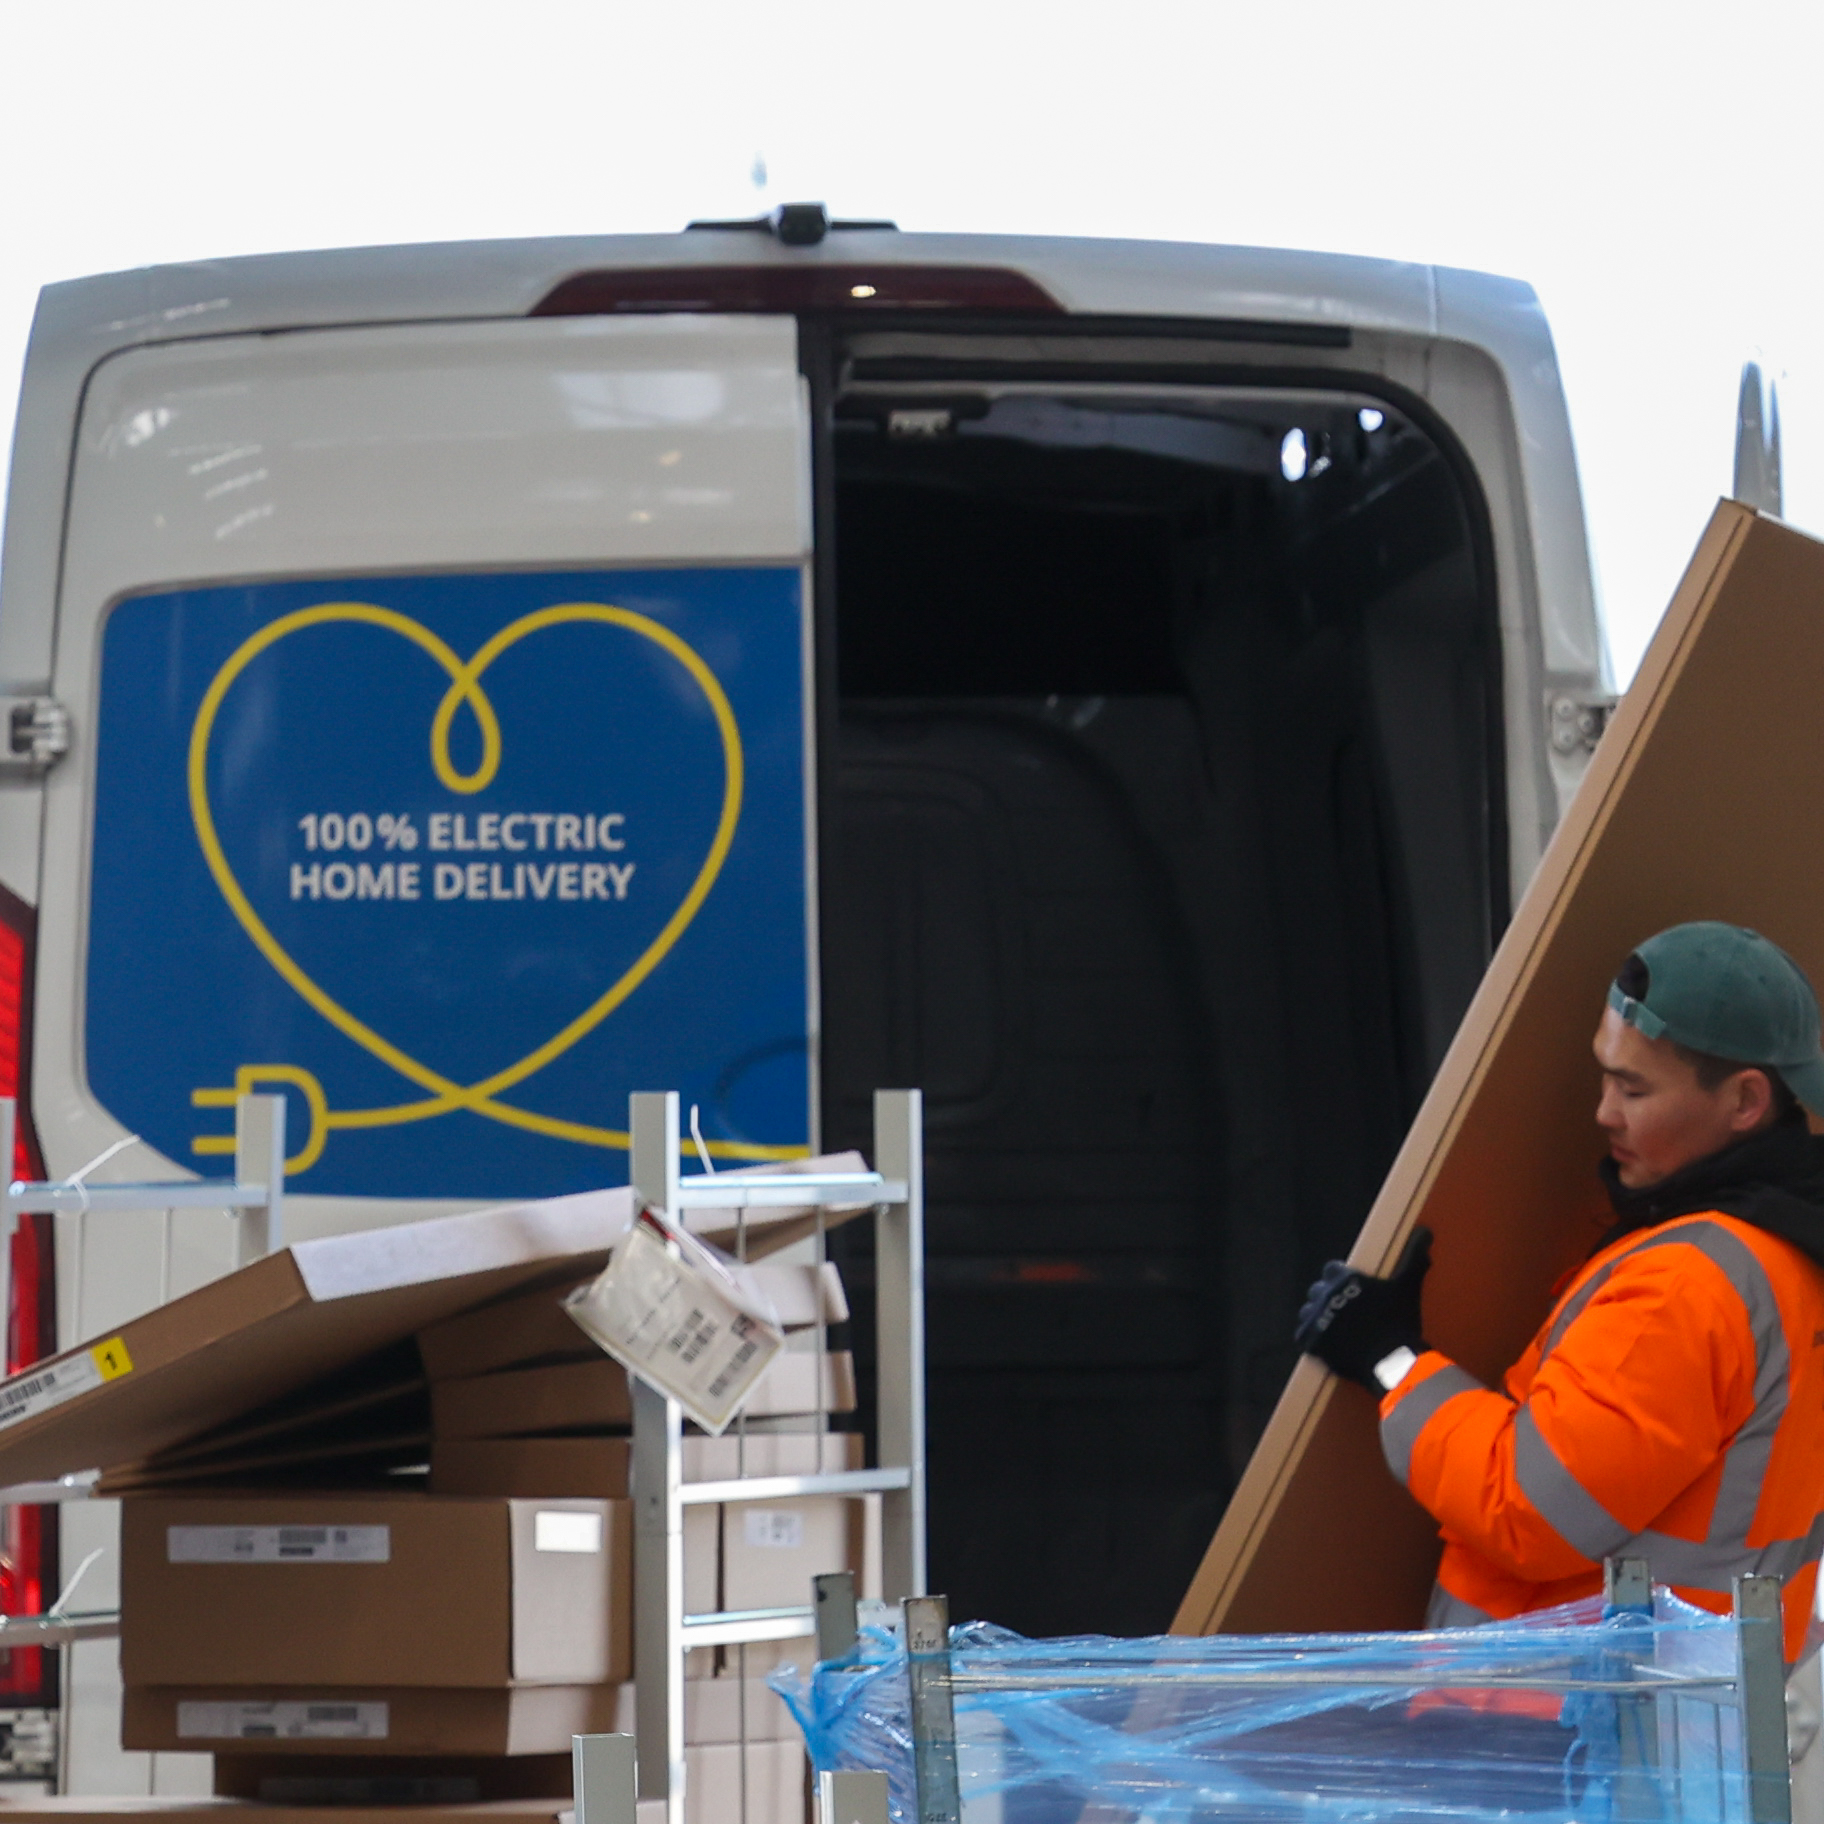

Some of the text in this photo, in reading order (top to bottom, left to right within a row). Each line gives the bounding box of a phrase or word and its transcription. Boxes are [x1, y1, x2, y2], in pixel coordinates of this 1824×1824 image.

[298, 812, 625, 851] 100% ELECTRIC
[289, 862, 635, 900] HOME DELIVERY
[104, 1351, 118, 1371] 1
